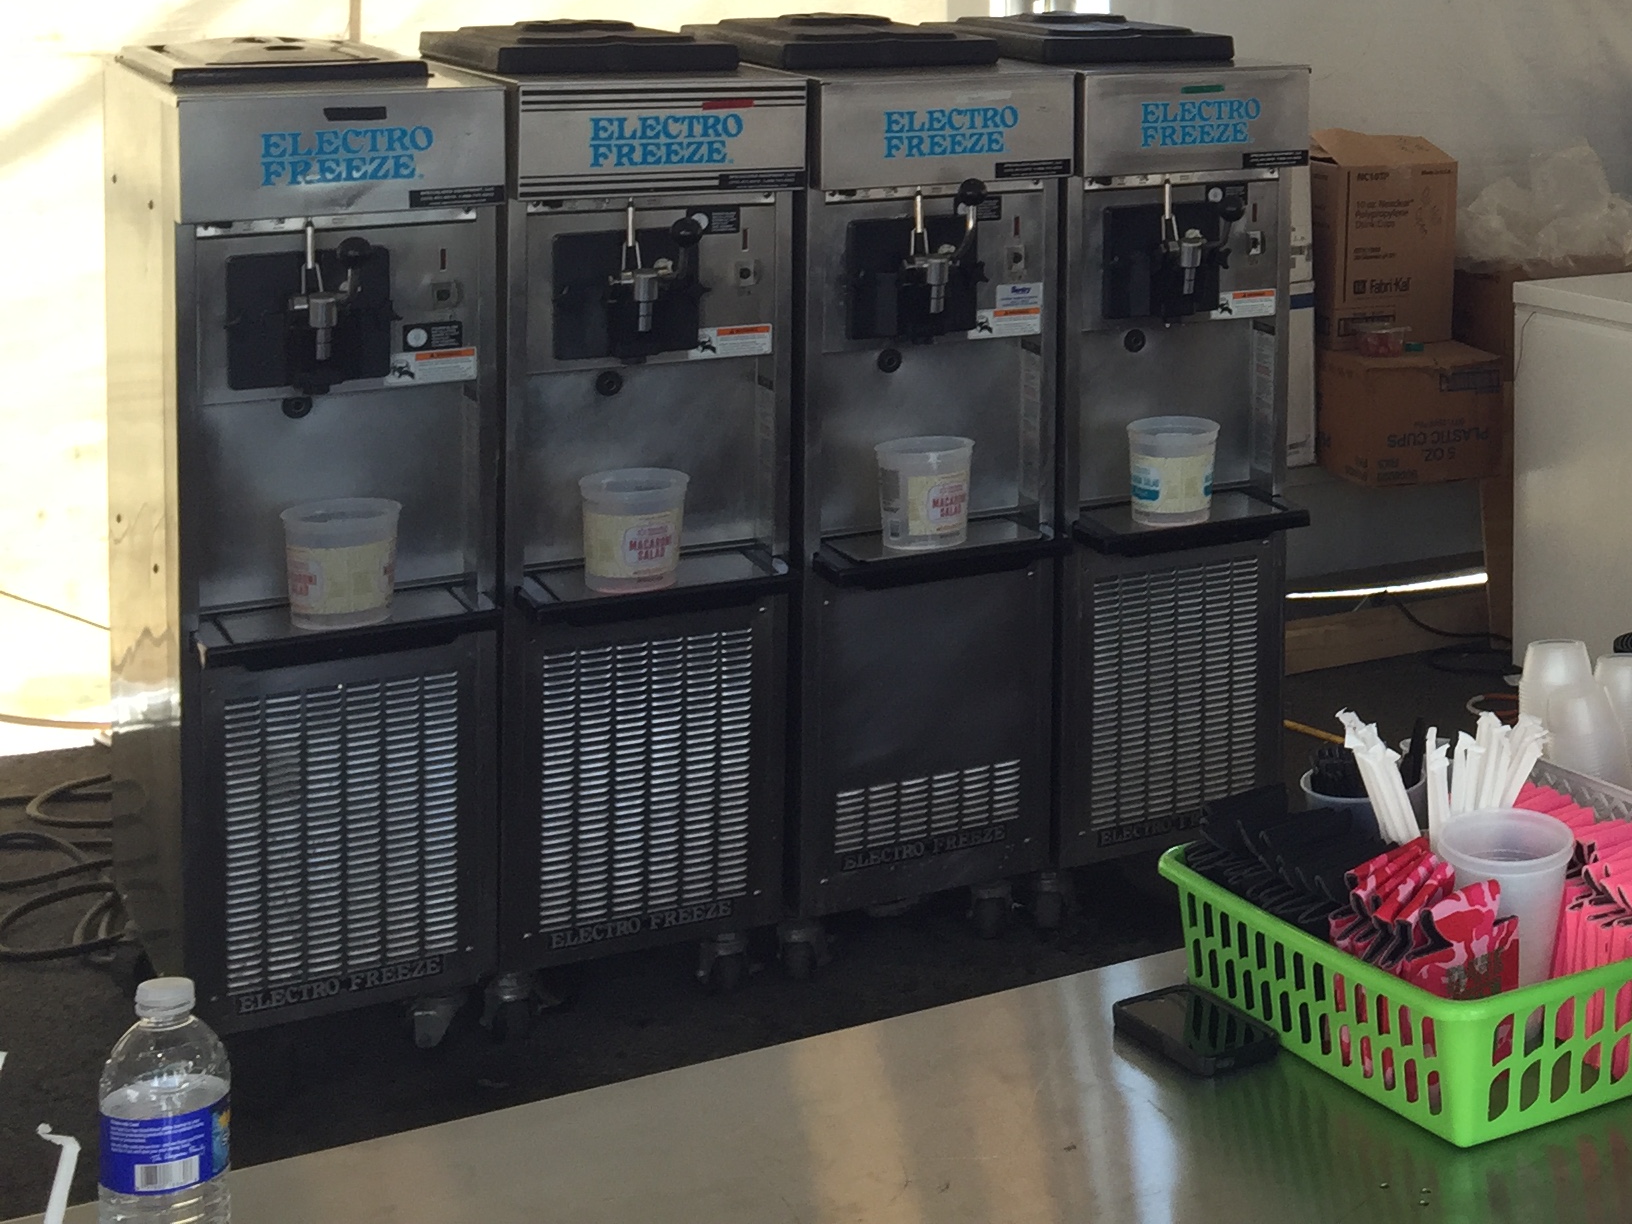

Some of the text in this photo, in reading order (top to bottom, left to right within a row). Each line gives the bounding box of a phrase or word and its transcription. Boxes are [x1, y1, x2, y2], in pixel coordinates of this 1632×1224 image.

[883, 106, 1020, 133] ELECTRO
[1140, 97, 1262, 124] ELECTRO
[261, 124, 434, 159] ELECTRO
[589, 113, 745, 142] ELECTRO
[1140, 122, 1250, 148] FREEZE
[589, 140, 729, 168] FREEZE
[883, 130, 1006, 159] FREEZE
[261, 153, 418, 187] FREEZE
[842, 824, 1007, 871] ELECTRO FREEZE
[550, 900, 732, 950] ELECTRO FREEZE
[238, 956, 443, 1013] ELECTRO FREEZE
